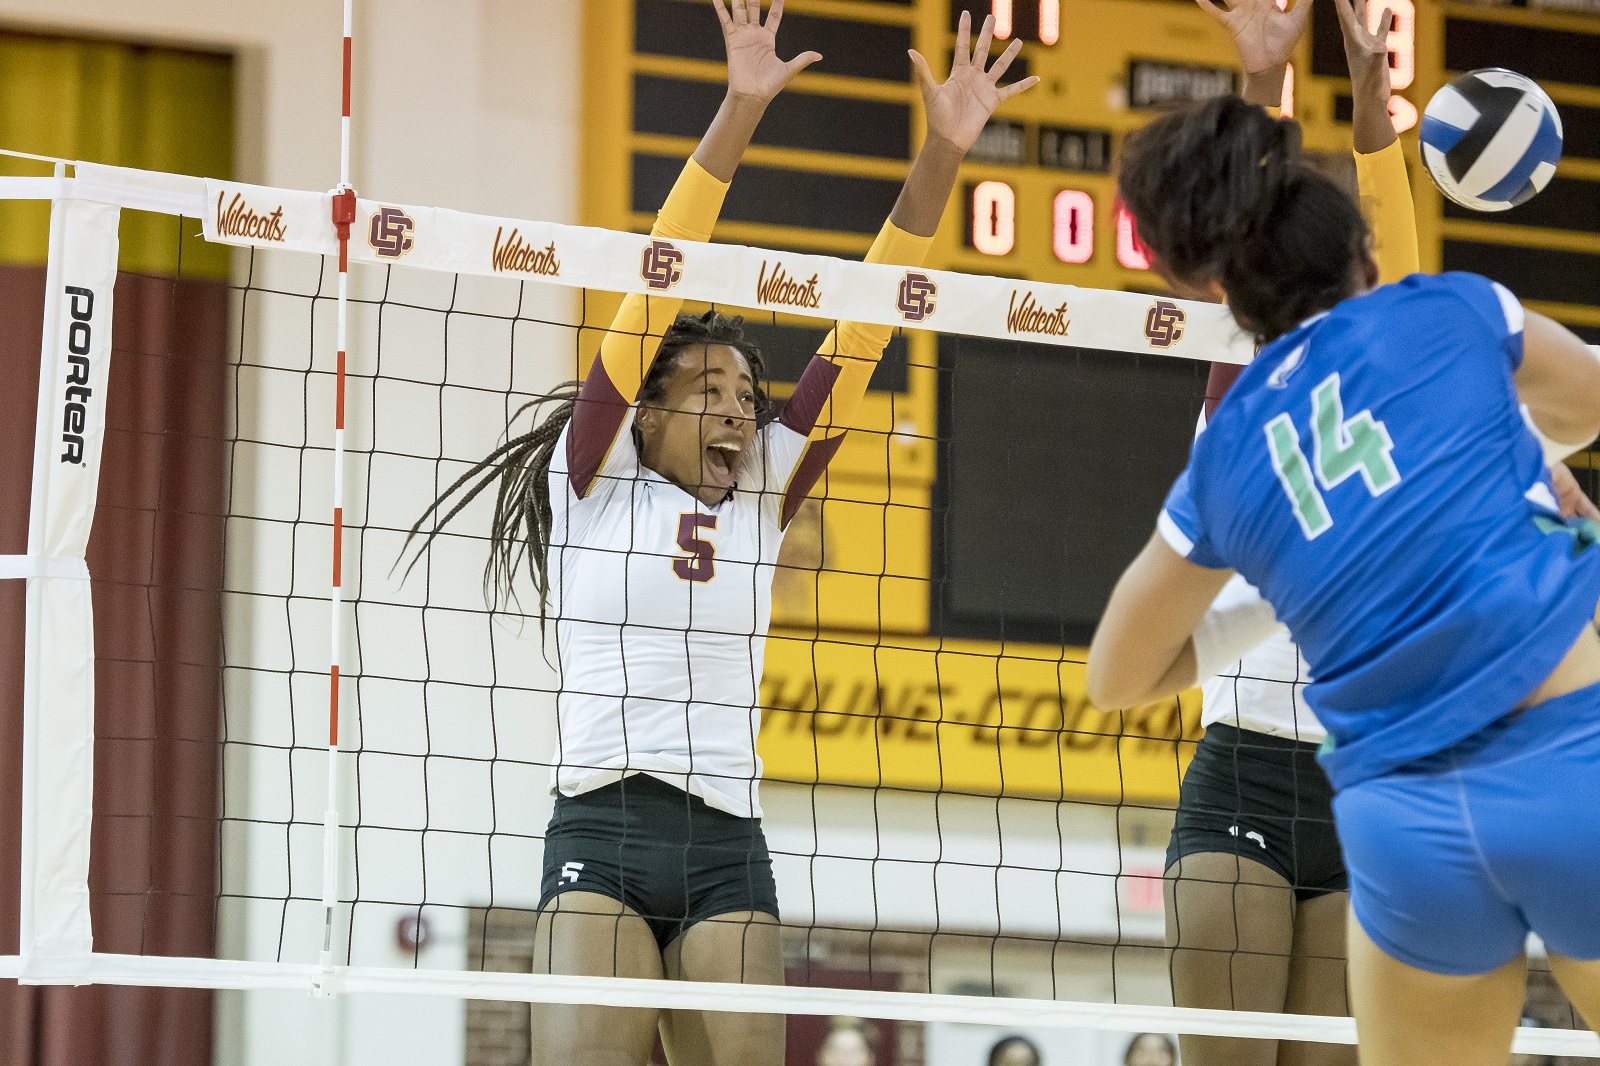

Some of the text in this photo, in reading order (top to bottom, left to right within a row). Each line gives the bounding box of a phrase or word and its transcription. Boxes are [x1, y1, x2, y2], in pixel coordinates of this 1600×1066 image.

[973, 181, 1015, 256] 0
[1053, 189, 1094, 264] 0
[216, 190, 287, 242] Wildcats
[492, 226, 561, 277] Wildcats
[757, 260, 822, 309] Wildcats
[1007, 289, 1071, 336] Wildcats
[1264, 371, 1402, 541] 14
[671, 512, 718, 584] 5
